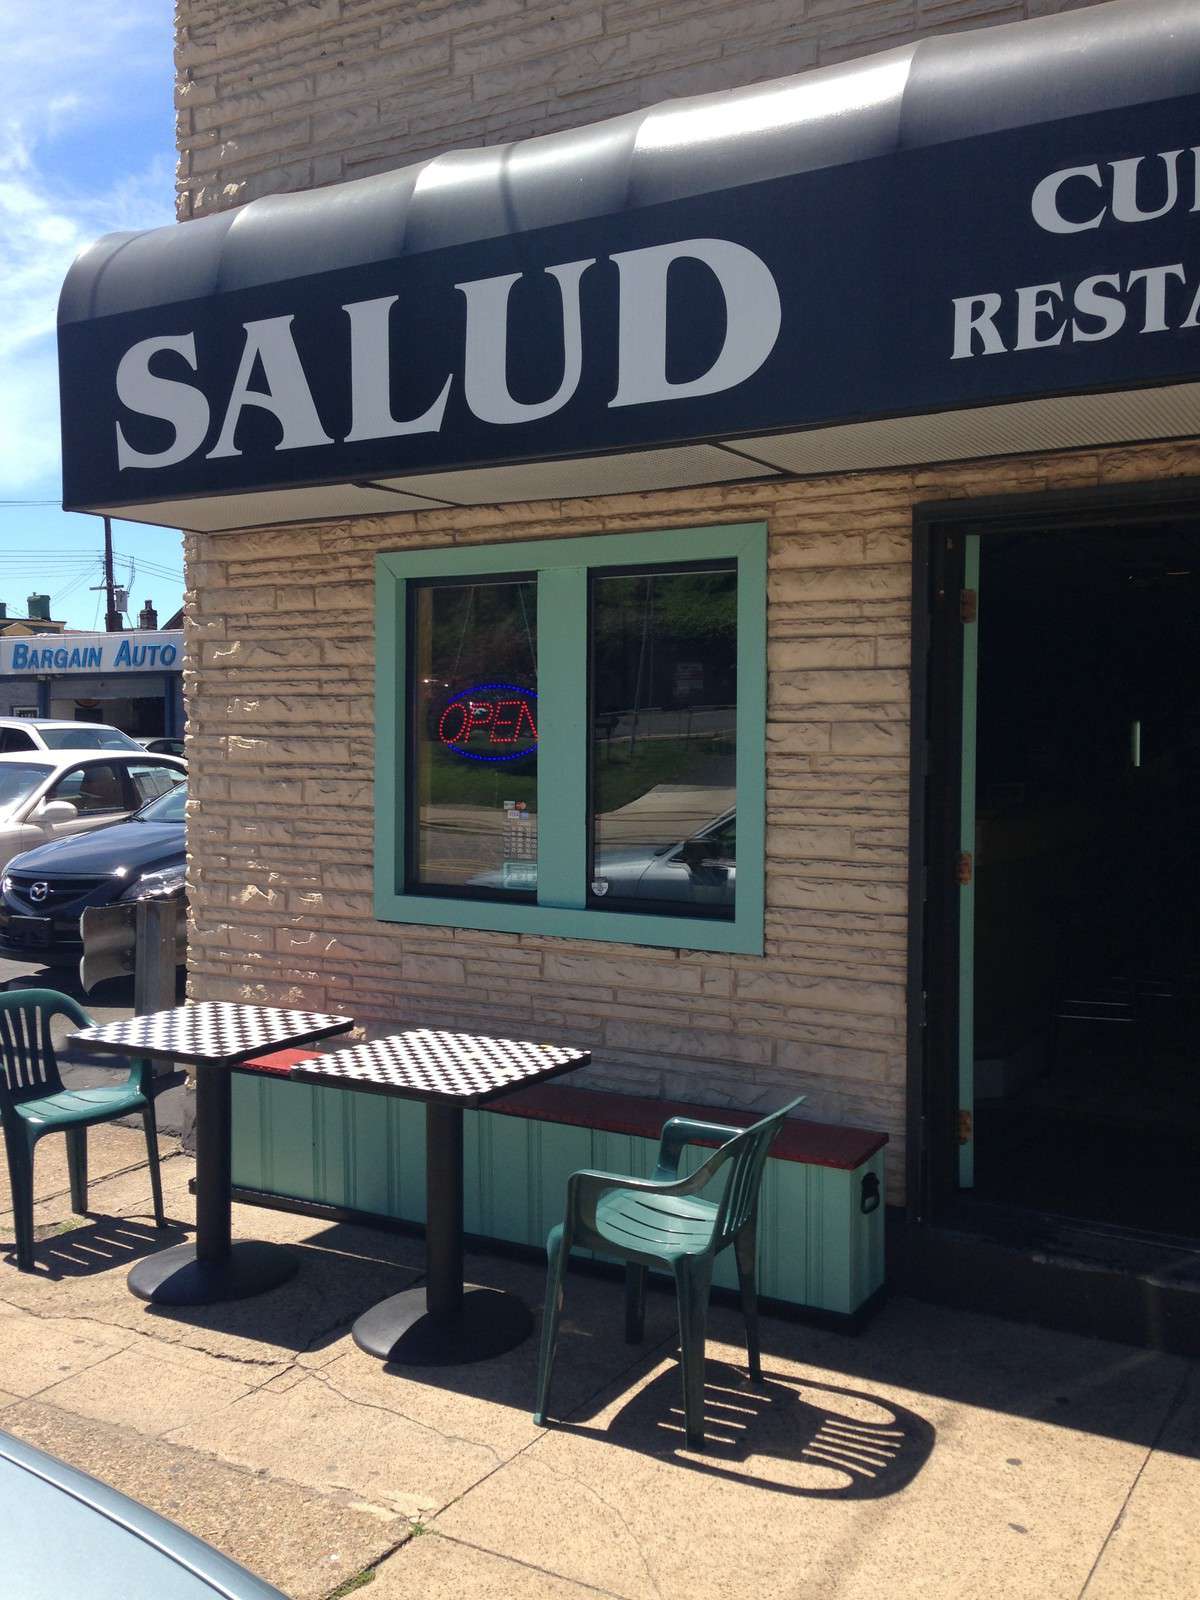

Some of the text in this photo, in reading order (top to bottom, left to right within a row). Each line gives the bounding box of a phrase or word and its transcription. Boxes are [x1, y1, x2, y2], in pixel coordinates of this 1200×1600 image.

[115, 238, 782, 471] SALUD
[12, 640, 177, 669] BARGAIN AUTO
